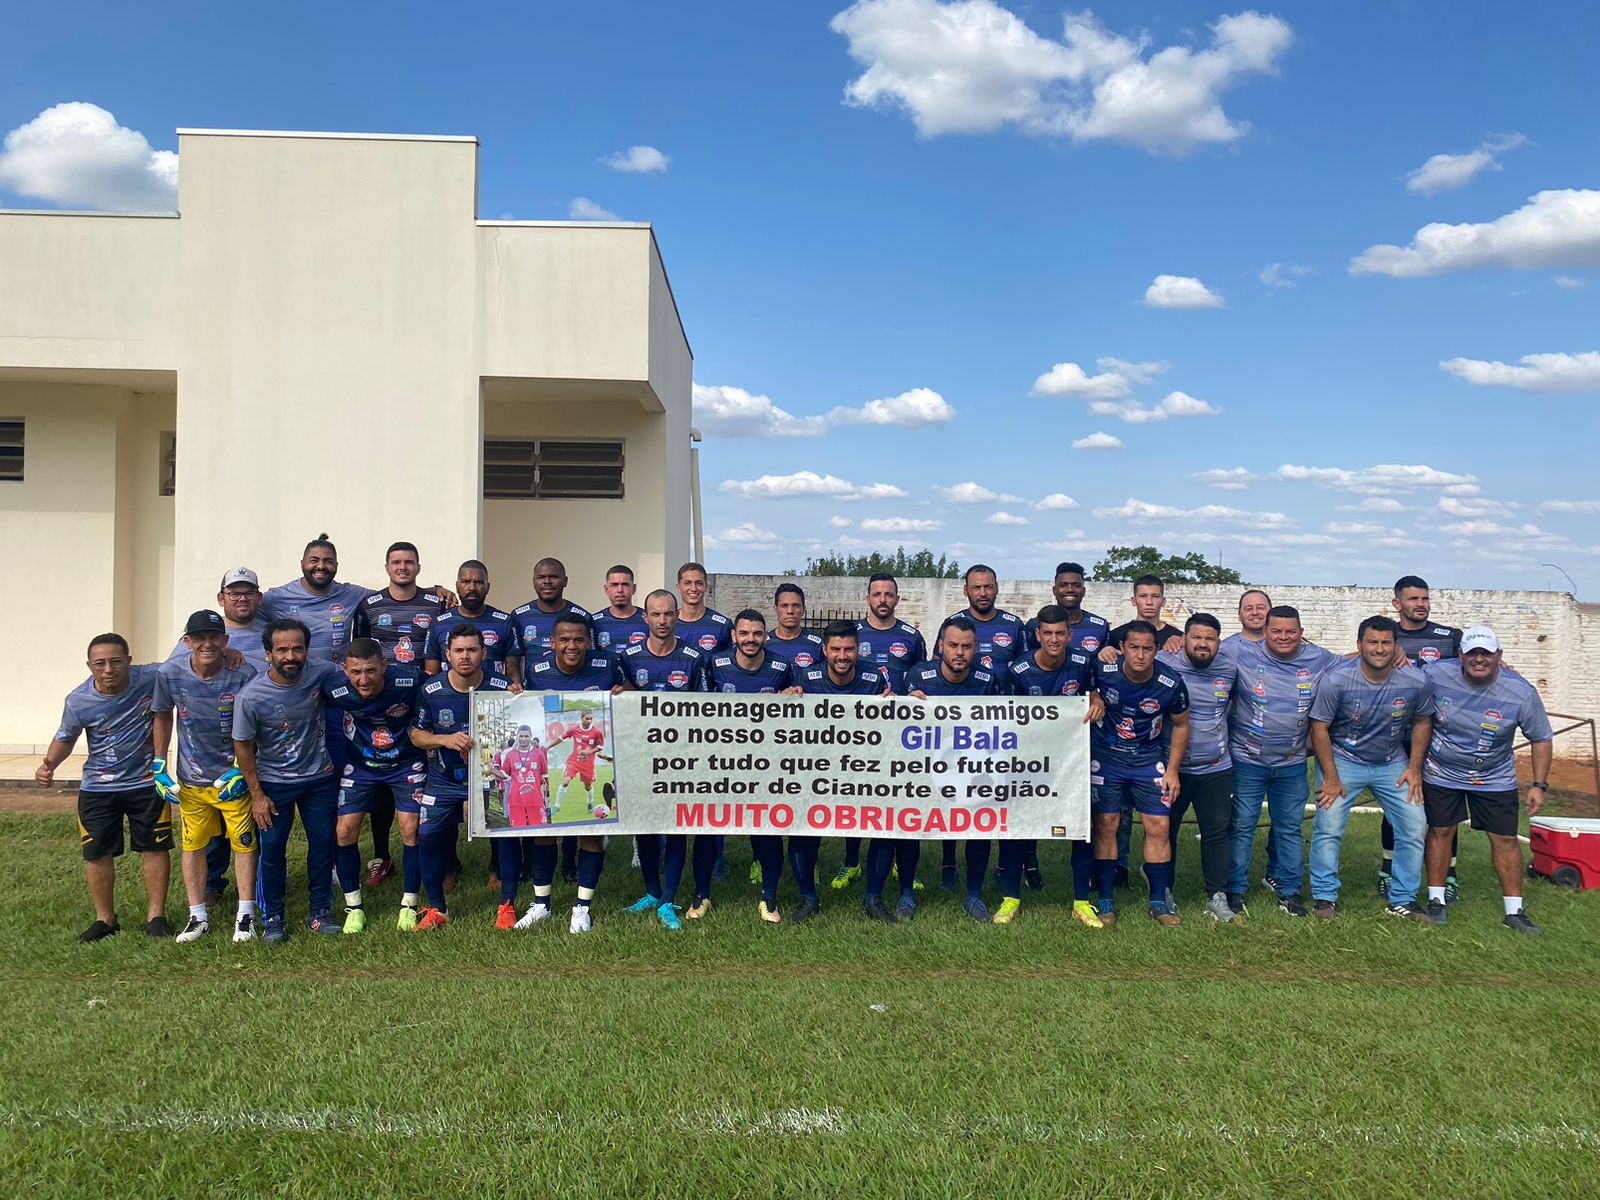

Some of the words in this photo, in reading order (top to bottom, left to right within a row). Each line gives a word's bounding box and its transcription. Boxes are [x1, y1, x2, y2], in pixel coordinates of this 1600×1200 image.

[640, 696, 805, 724] Homenagem
[814, 698, 846, 720] de
[854, 700, 926, 721] todos
[934, 704, 962, 721] os
[970, 700, 1060, 726] amigos
[646, 727, 679, 744] ao
[688, 727, 765, 744] nosso
[774, 725, 882, 746] saudoso
[901, 725, 942, 750] Gil
[953, 725, 1018, 751] Bala
[652, 756, 700, 775] por
[708, 753, 771, 771] tudo
[779, 757, 831, 777] que
[839, 754, 881, 773] fez
[890, 756, 949, 777] pelo
[957, 756, 1051, 774] futebol
[652, 777, 760, 794] amador
[768, 777, 802, 795] de
[811, 777, 932, 798] Cianorte
[940, 784, 957, 798] e
[966, 780, 1058, 801] região.
[676, 803, 795, 829] MUITO
[807, 804, 1008, 833] OBRIGADO!
